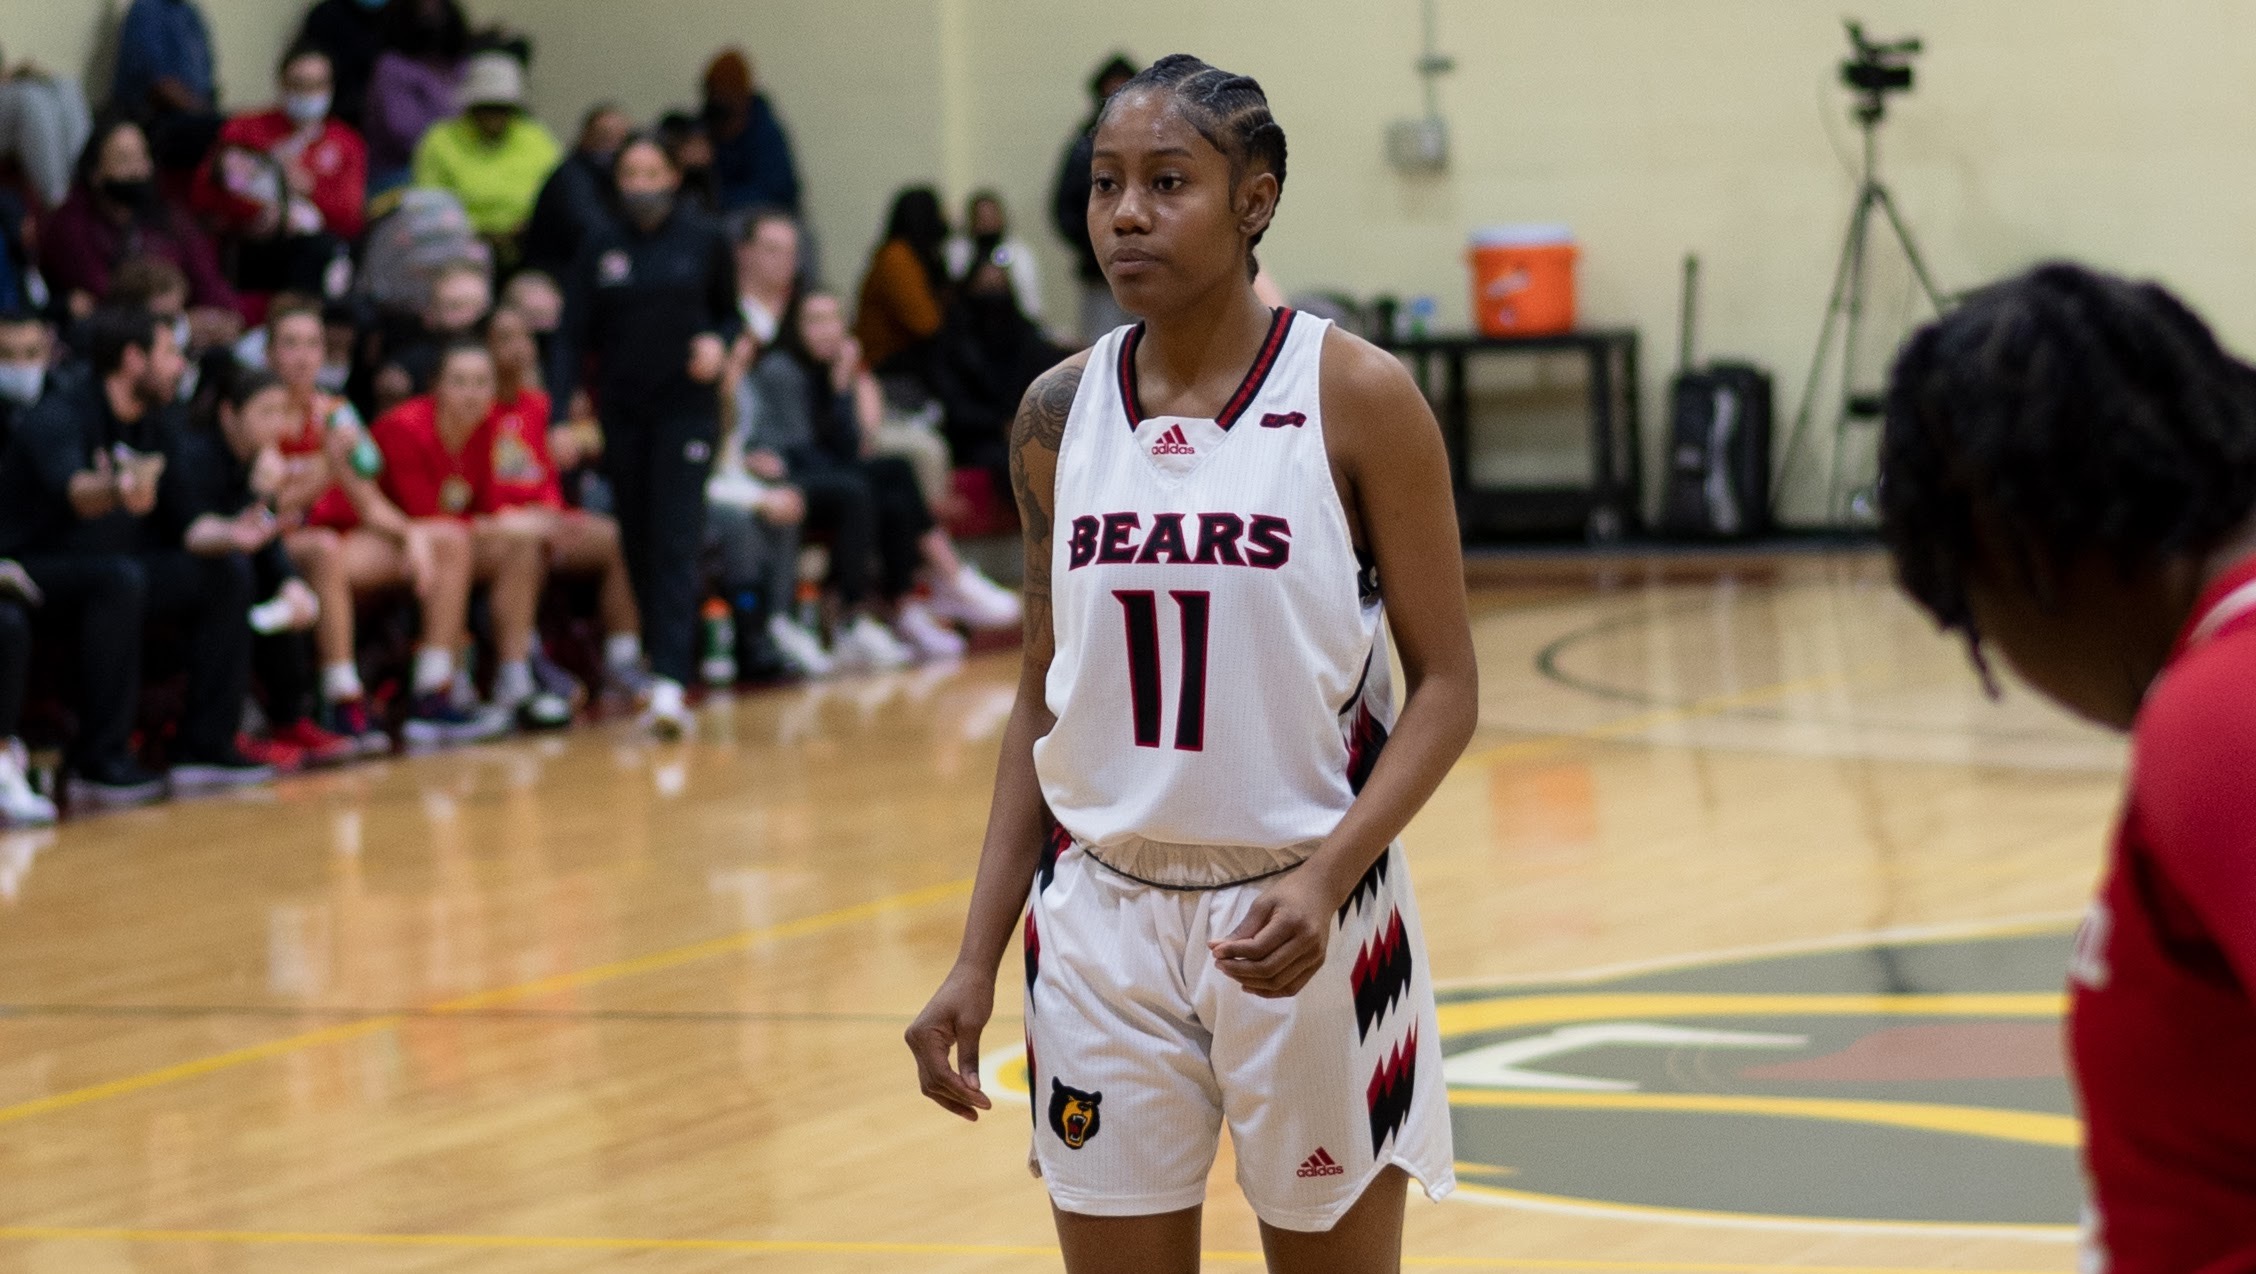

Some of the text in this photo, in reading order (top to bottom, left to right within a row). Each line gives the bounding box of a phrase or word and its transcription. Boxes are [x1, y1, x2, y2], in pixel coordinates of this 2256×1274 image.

[1151, 442, 1195, 456] adidas
[1067, 512, 1292, 571] BEARS
[1111, 590, 1210, 751] 11
[1296, 1165, 1344, 1178] adidas
